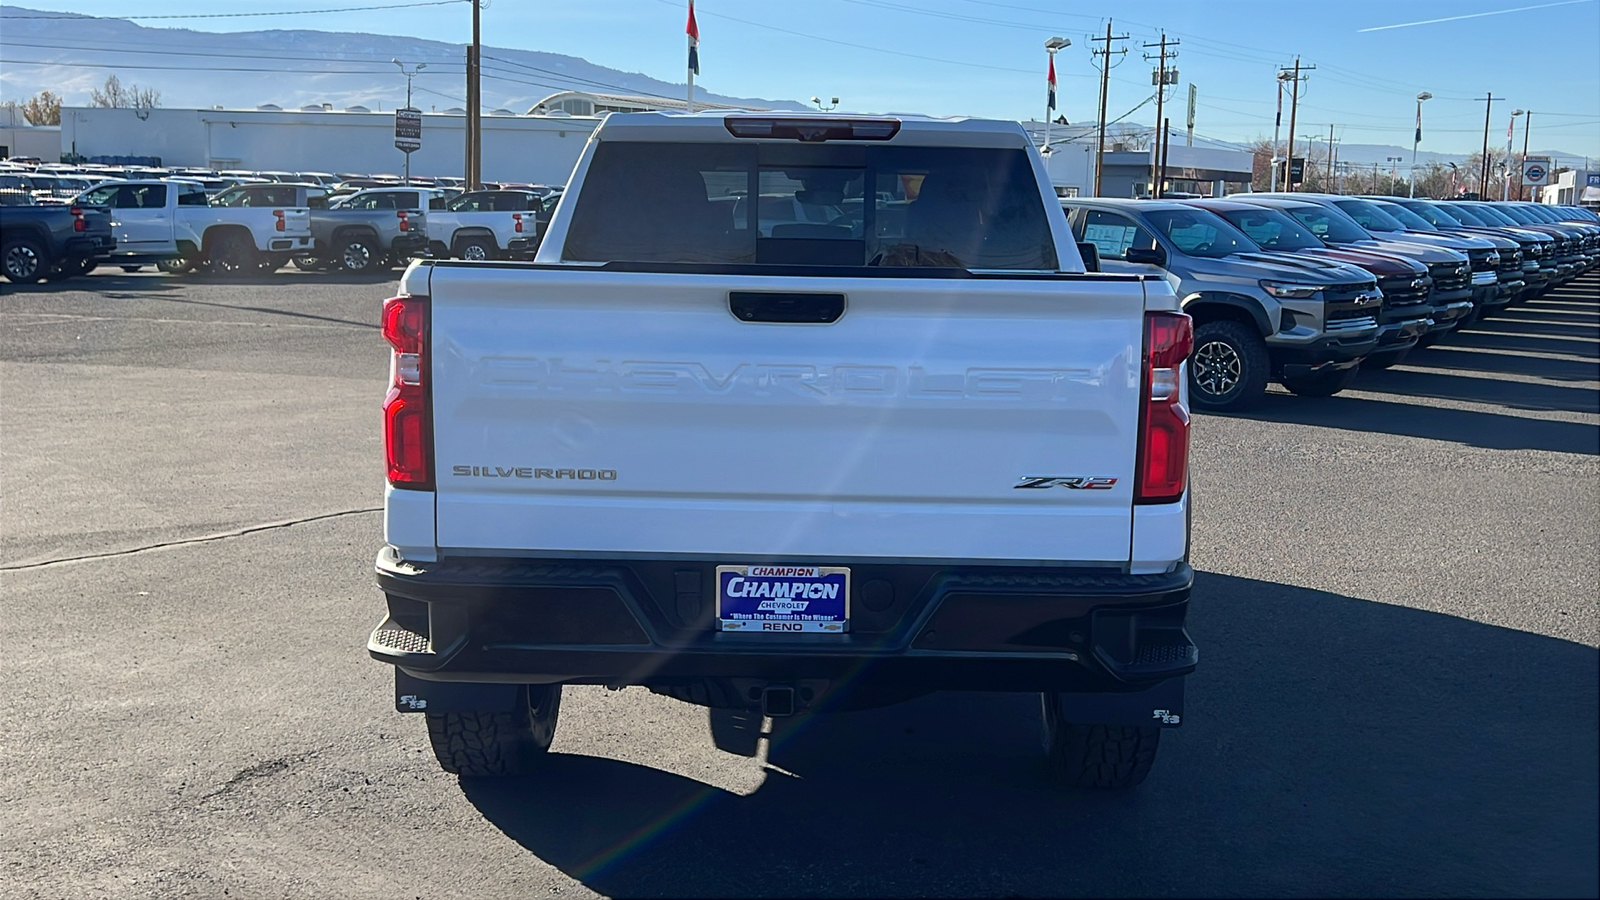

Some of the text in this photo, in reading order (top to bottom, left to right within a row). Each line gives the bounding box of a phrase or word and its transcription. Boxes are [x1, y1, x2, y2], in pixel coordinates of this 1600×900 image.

[476, 356, 1093, 399] CHEVROLET
[452, 465, 617, 481] SILVERADO
[1013, 476, 1118, 490] ZR2
[752, 567, 814, 577] CHAMPION
[726, 577, 839, 599] CHAMPION
[762, 622, 803, 631] RENO
